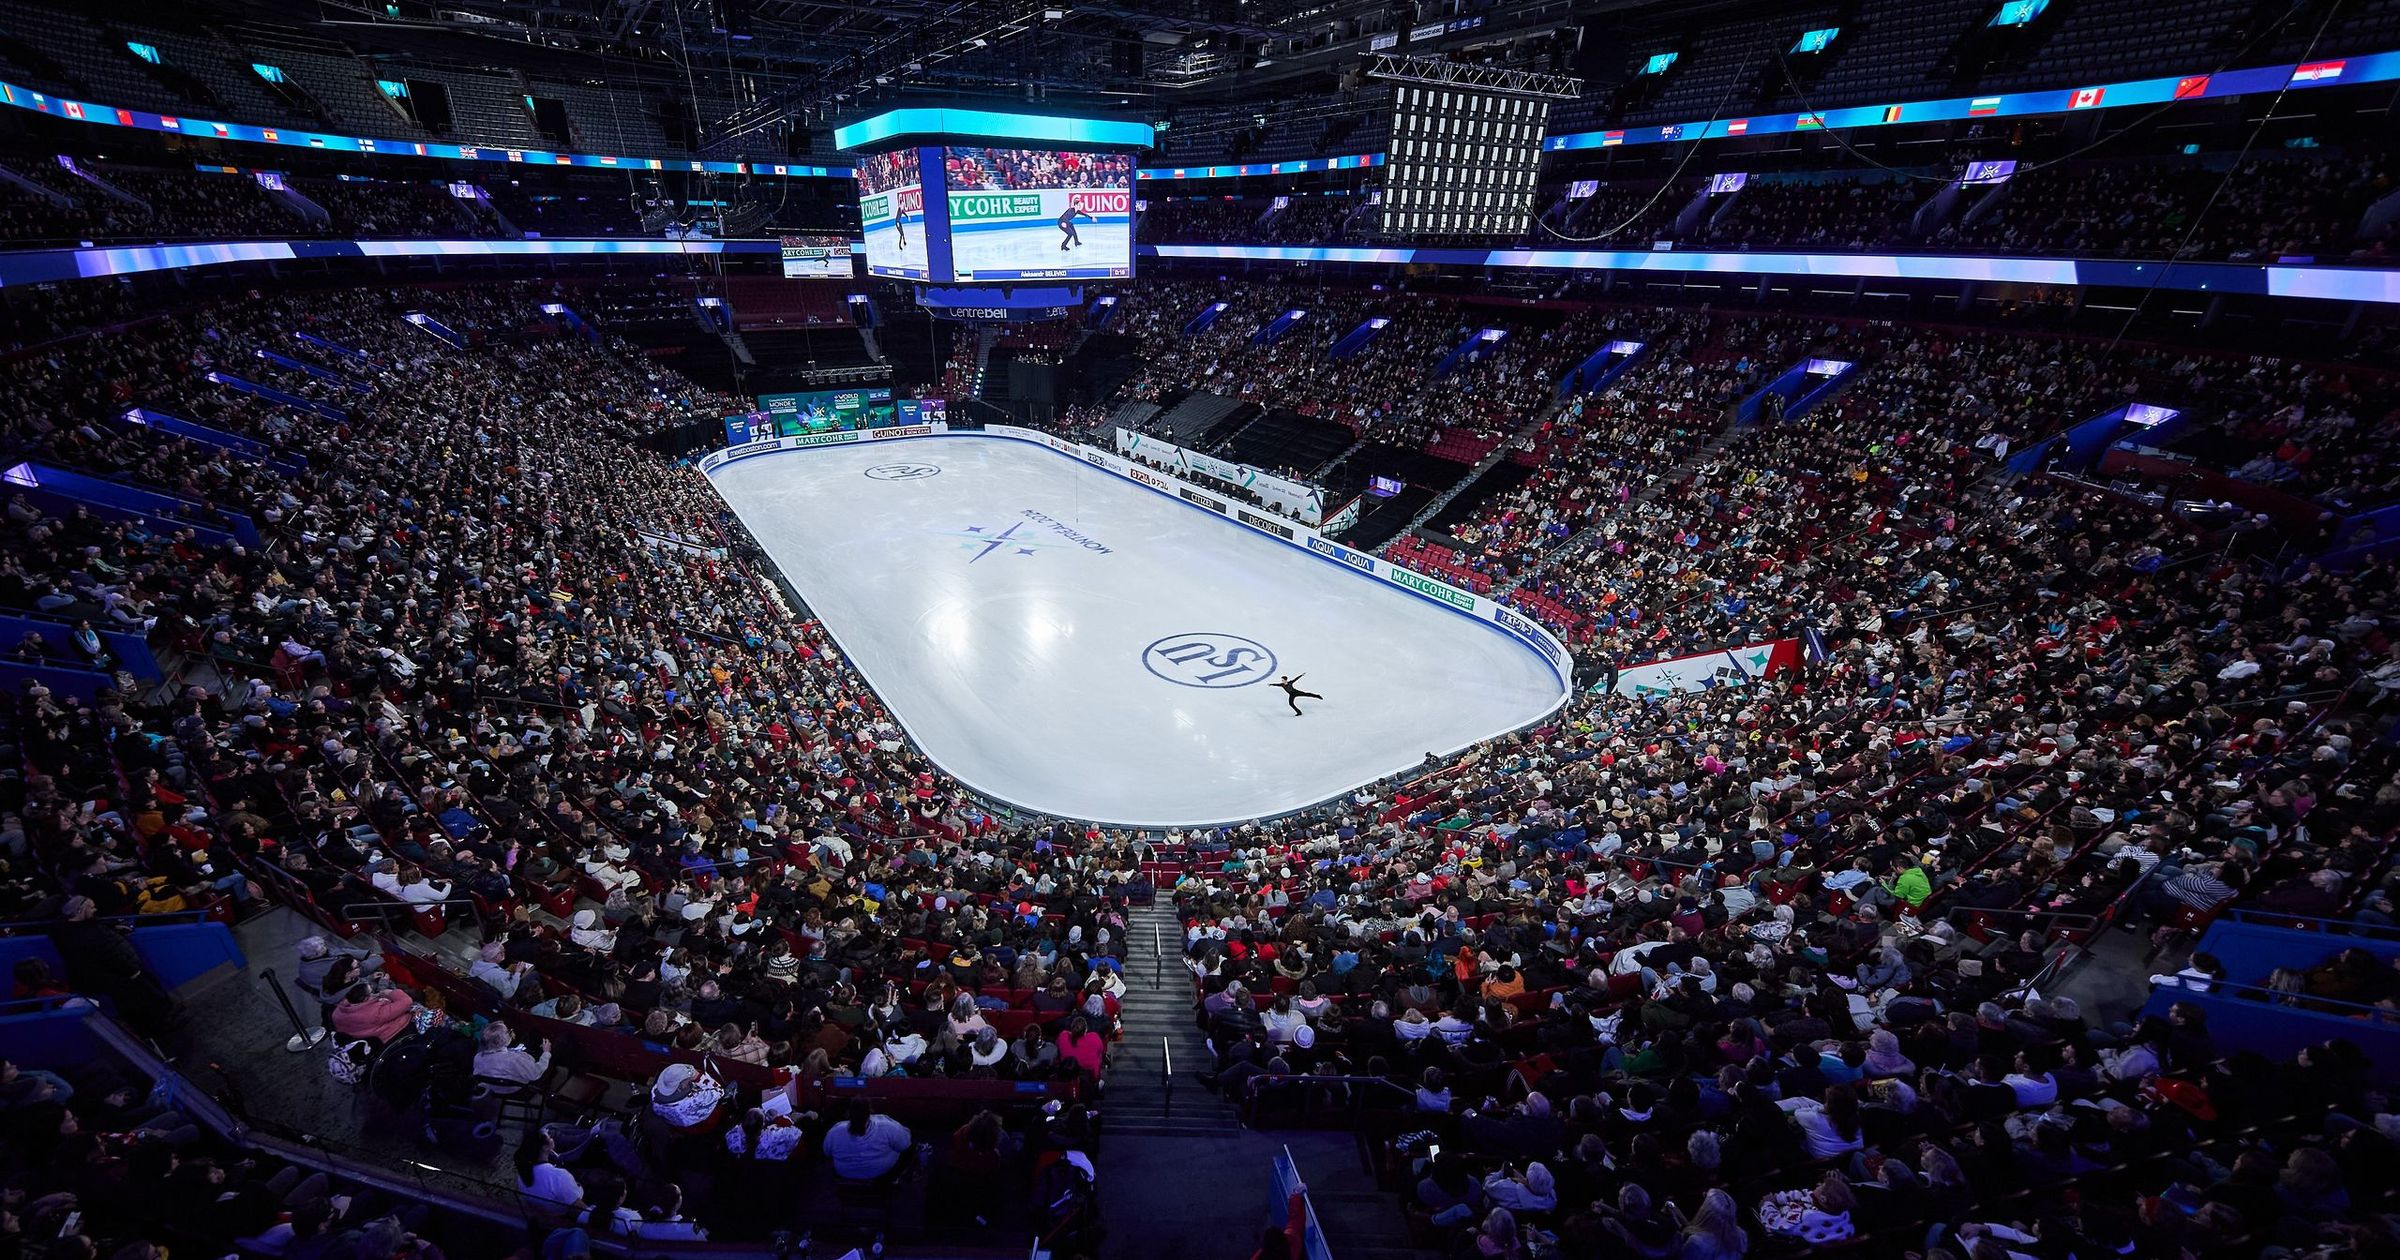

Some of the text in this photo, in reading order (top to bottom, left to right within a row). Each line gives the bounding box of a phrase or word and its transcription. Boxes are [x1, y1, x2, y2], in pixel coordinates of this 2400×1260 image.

[964, 197, 1013, 217] COHR
[797, 437, 820, 445] MARY
[820, 435, 844, 443] COHR
[873, 429, 906, 438] GUINOT
[1191, 492, 1215, 509] CITIZEN
[1311, 539, 1370, 570] AQUA AQUA
[1393, 571, 1454, 602] MARY COHR
[1154, 642, 1266, 684] ISU
